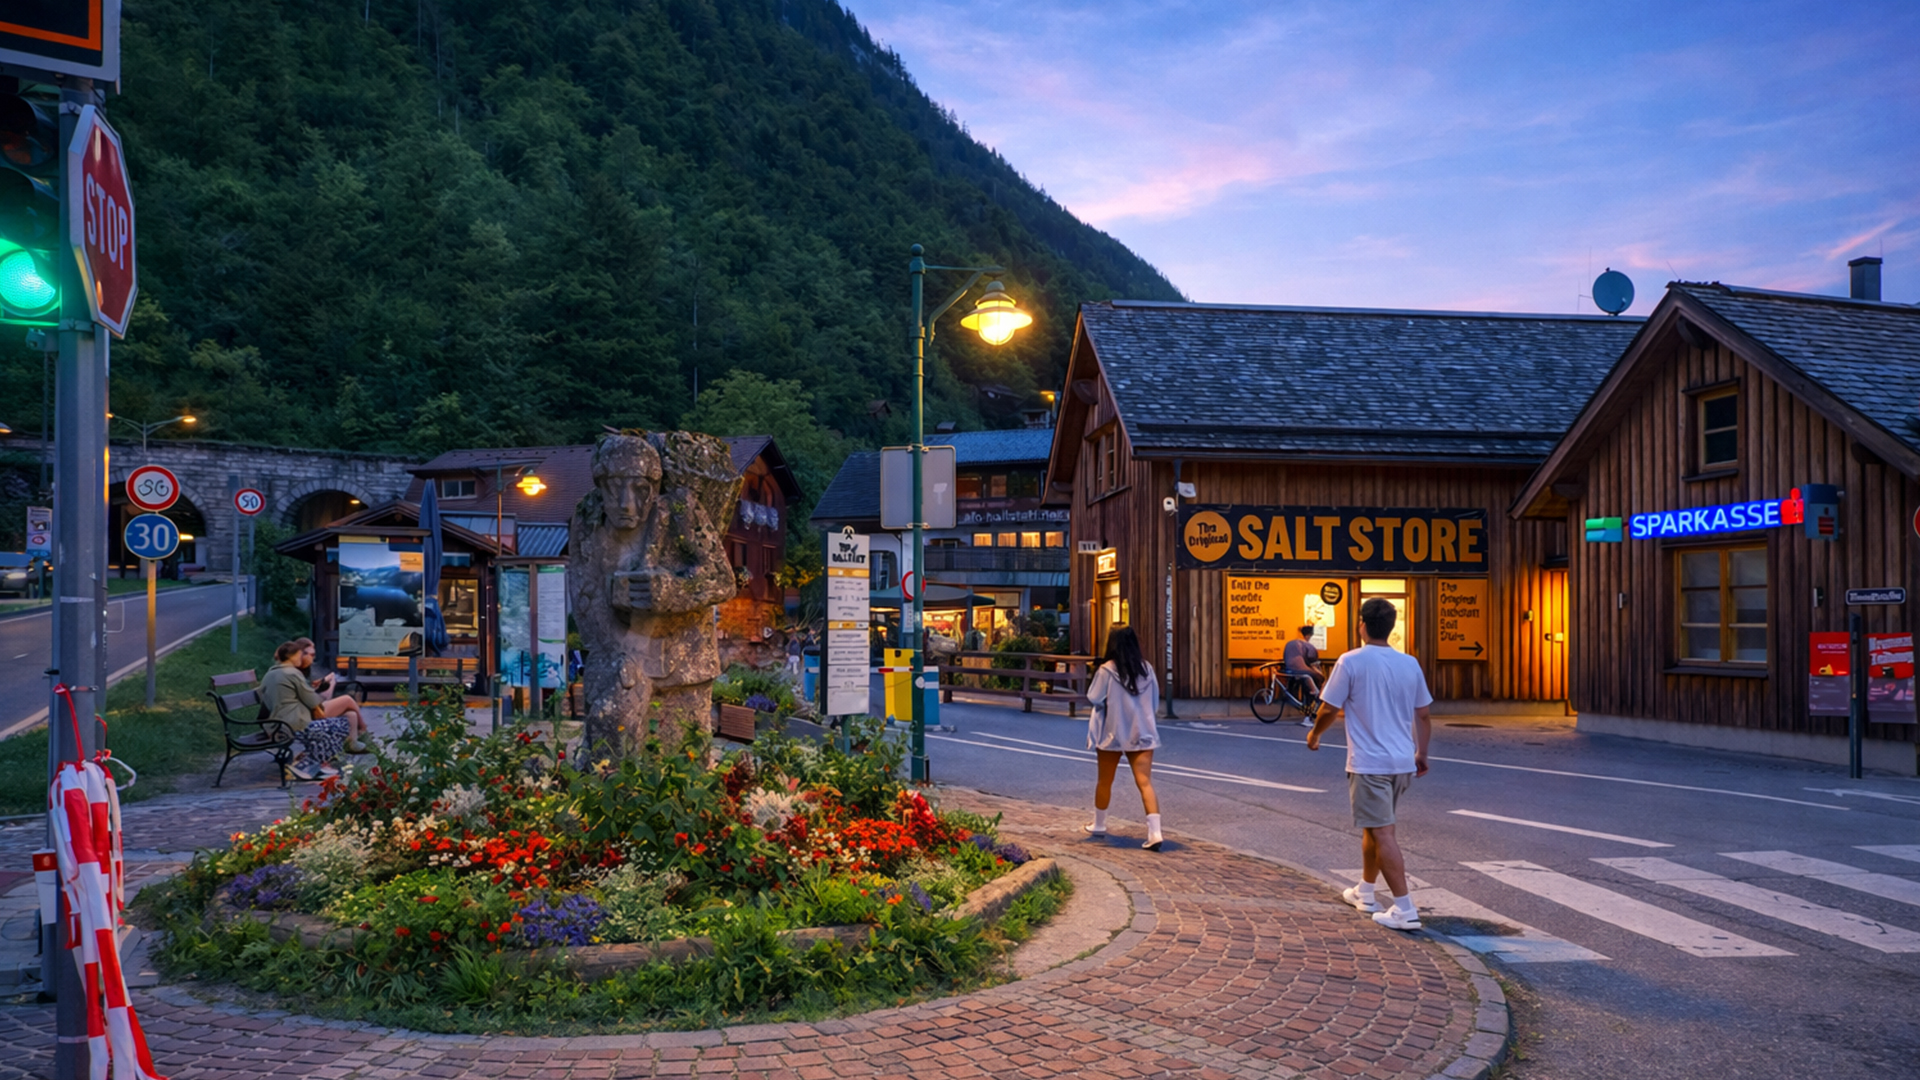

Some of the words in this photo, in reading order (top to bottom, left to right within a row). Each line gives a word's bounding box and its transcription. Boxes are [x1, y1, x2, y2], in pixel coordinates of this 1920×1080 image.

[86, 172, 128, 270] STOP
[133, 523, 170, 552] 30
[1238, 514, 1341, 560] SALT
[1348, 516, 1483, 562] STORE
[1632, 501, 1779, 537] SPARKASSE
